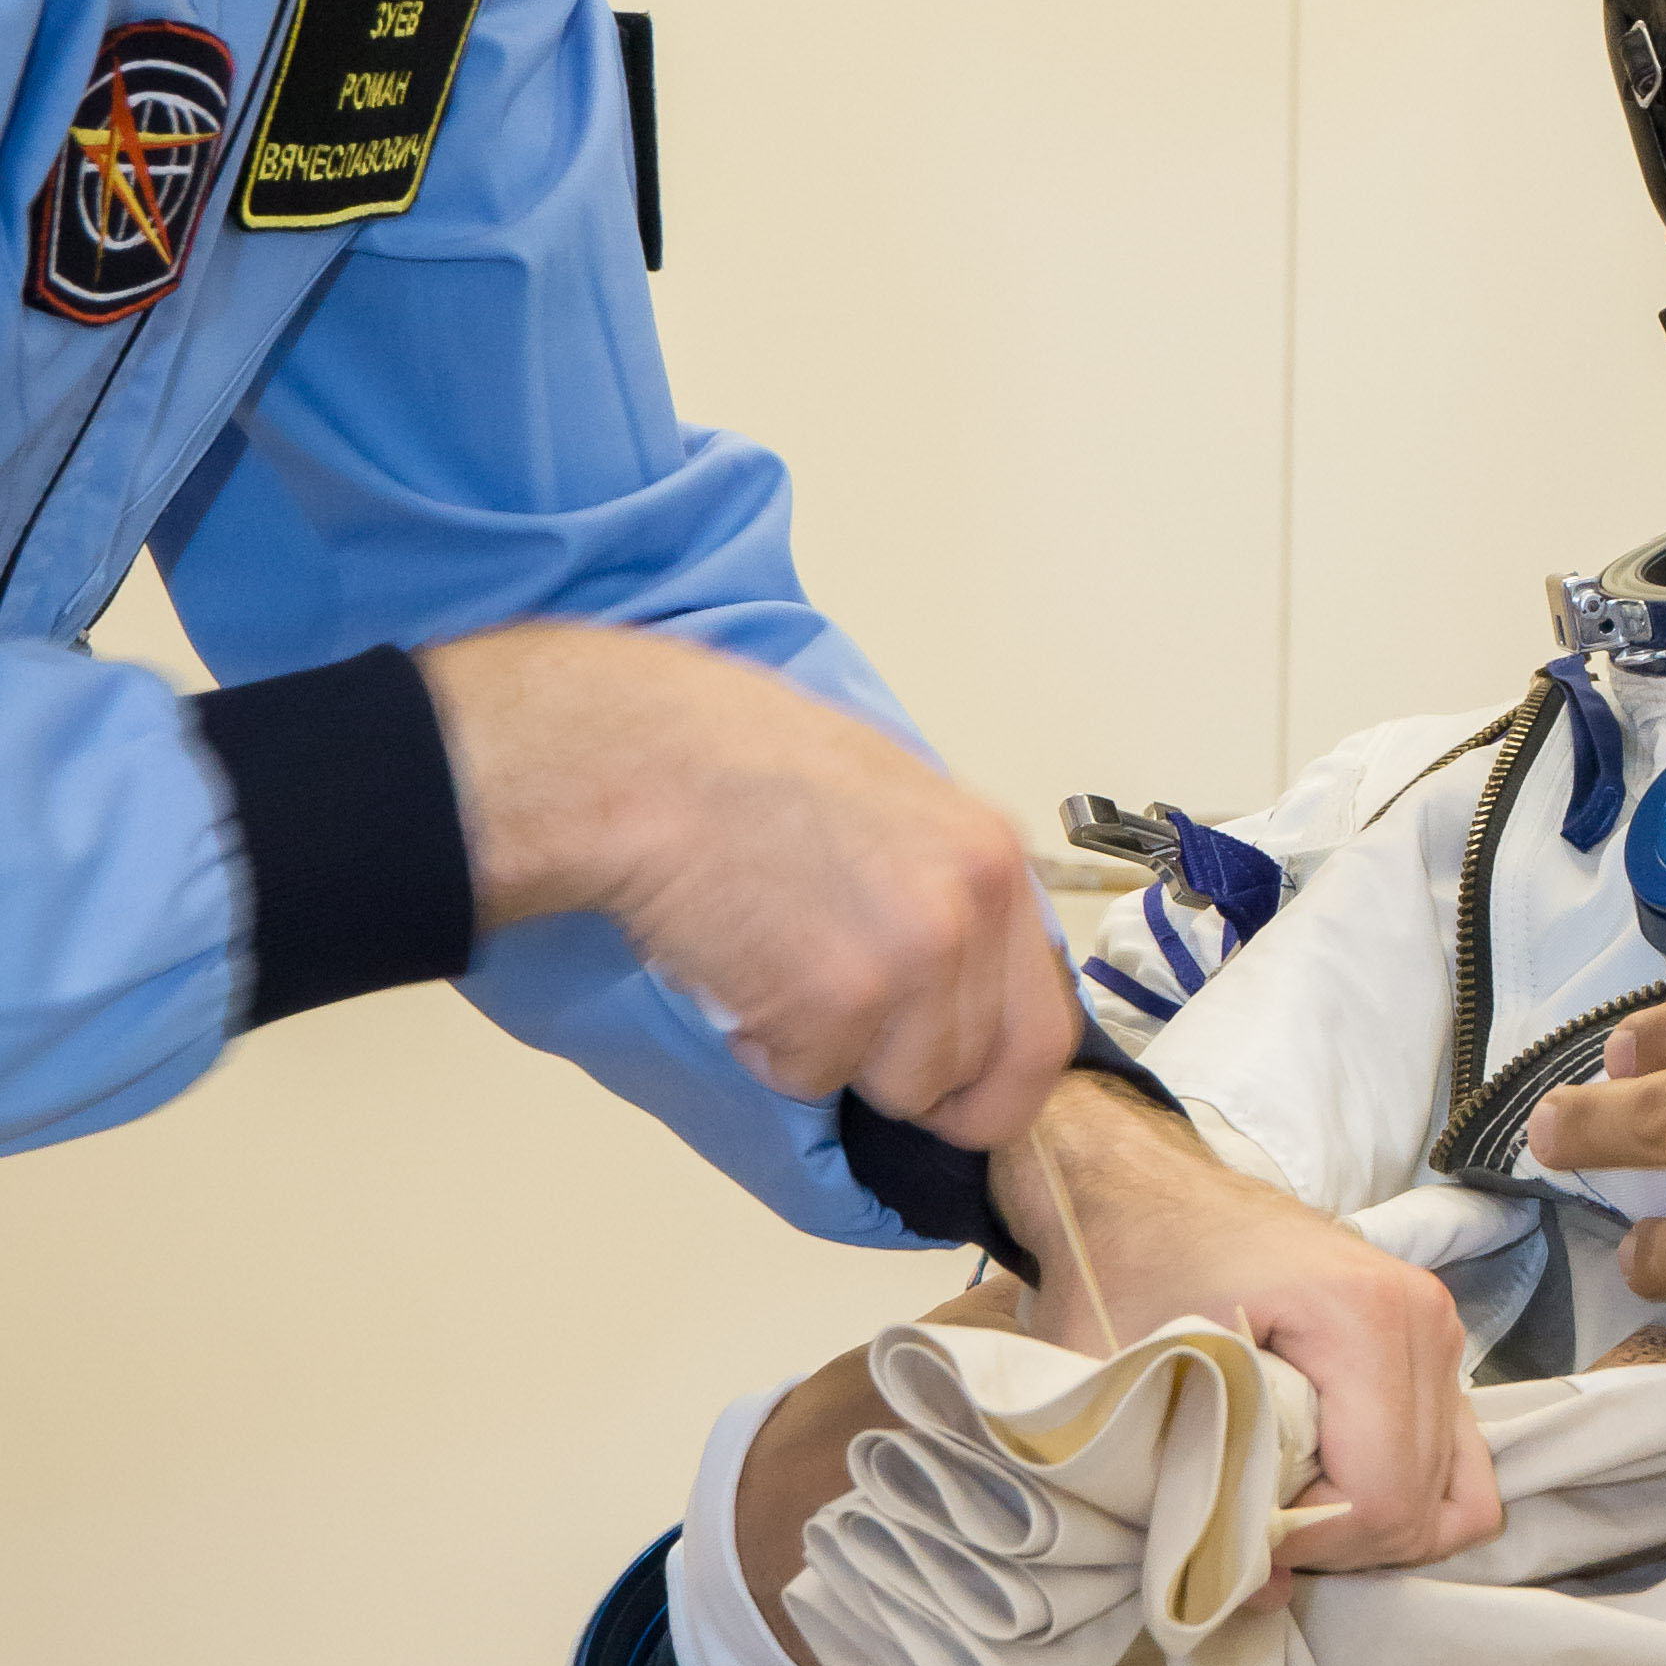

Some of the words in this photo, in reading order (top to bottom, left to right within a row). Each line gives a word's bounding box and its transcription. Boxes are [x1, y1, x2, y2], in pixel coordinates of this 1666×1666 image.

[369, 0, 425, 40] ЗУЕВ
[337, 70, 413, 110] РОМАН
[257, 133, 426, 181] ВЯЧЕСЛАВОВИЧ
